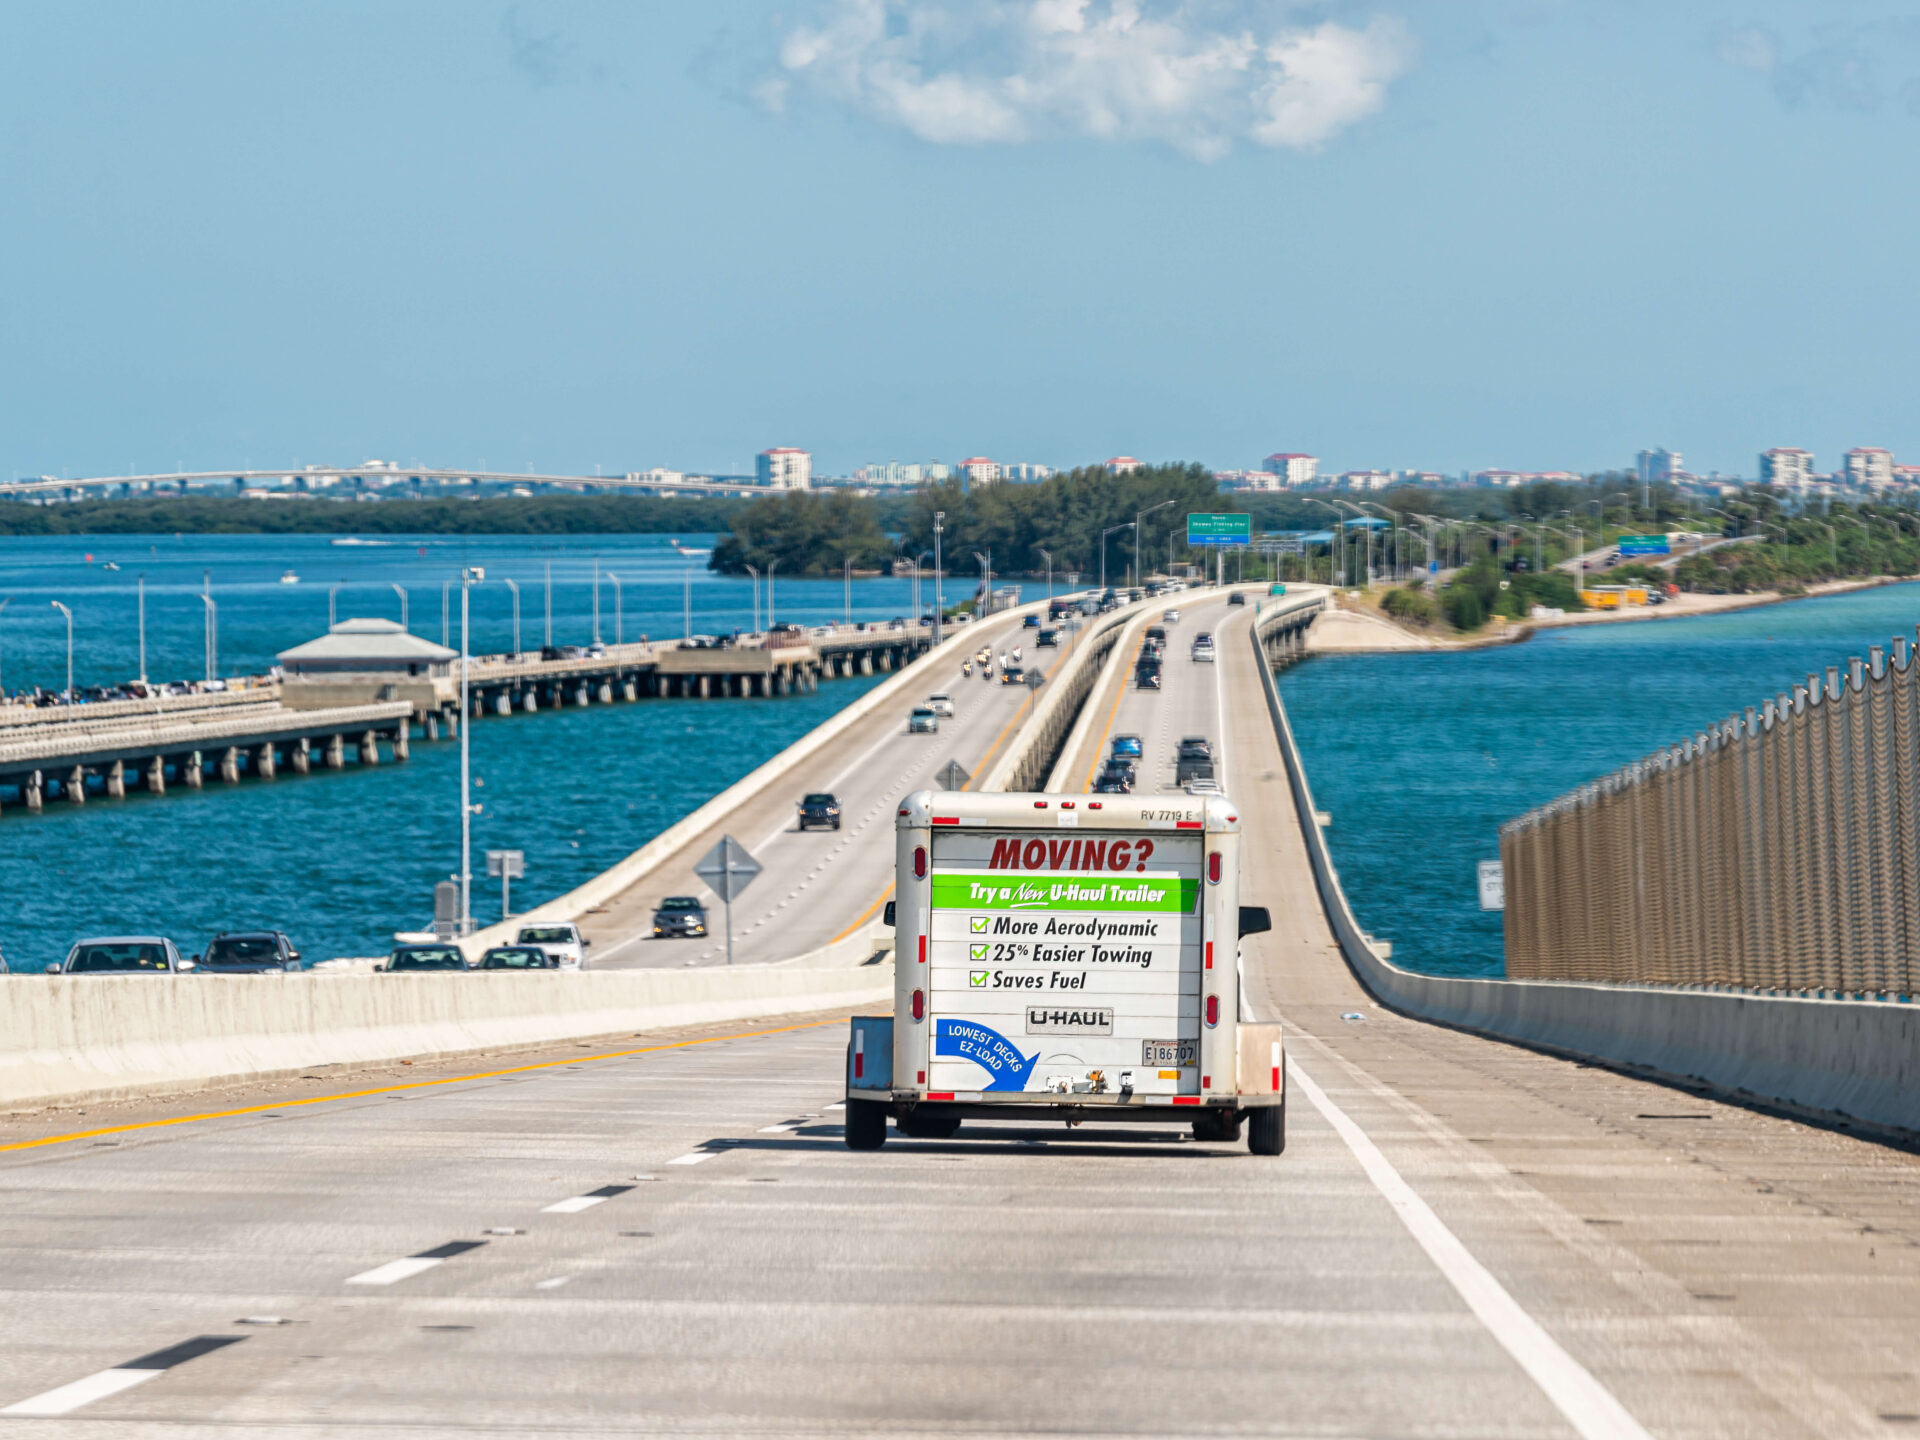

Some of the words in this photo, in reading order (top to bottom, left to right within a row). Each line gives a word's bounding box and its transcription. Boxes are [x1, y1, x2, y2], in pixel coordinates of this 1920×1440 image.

[1141, 810, 1155, 821] RV
[1159, 810, 1182, 821] 7719
[988, 838, 1154, 873] MOVING?
[969, 882, 998, 904] Try
[999, 886, 1012, 900] a
[1012, 882, 1049, 901] New
[1050, 883, 1106, 901] U-Haul
[1110, 884, 1166, 903] Trailer
[993, 916, 1038, 935] More
[1044, 917, 1158, 940] Aerodynamic
[993, 943, 1029, 962] 25%
[1032, 944, 1086, 963] Easier
[1091, 944, 1153, 969] Towing
[992, 970, 1044, 989] Saves
[1050, 971, 1087, 990] Fuel
[1030, 1010, 1110, 1026] U-HAUL
[948, 1025, 994, 1046] LOWEST
[993, 1041, 1023, 1073] DECKS
[959, 1040, 1003, 1071] EZ-LOAD
[1145, 1046, 1194, 1060] E186707
